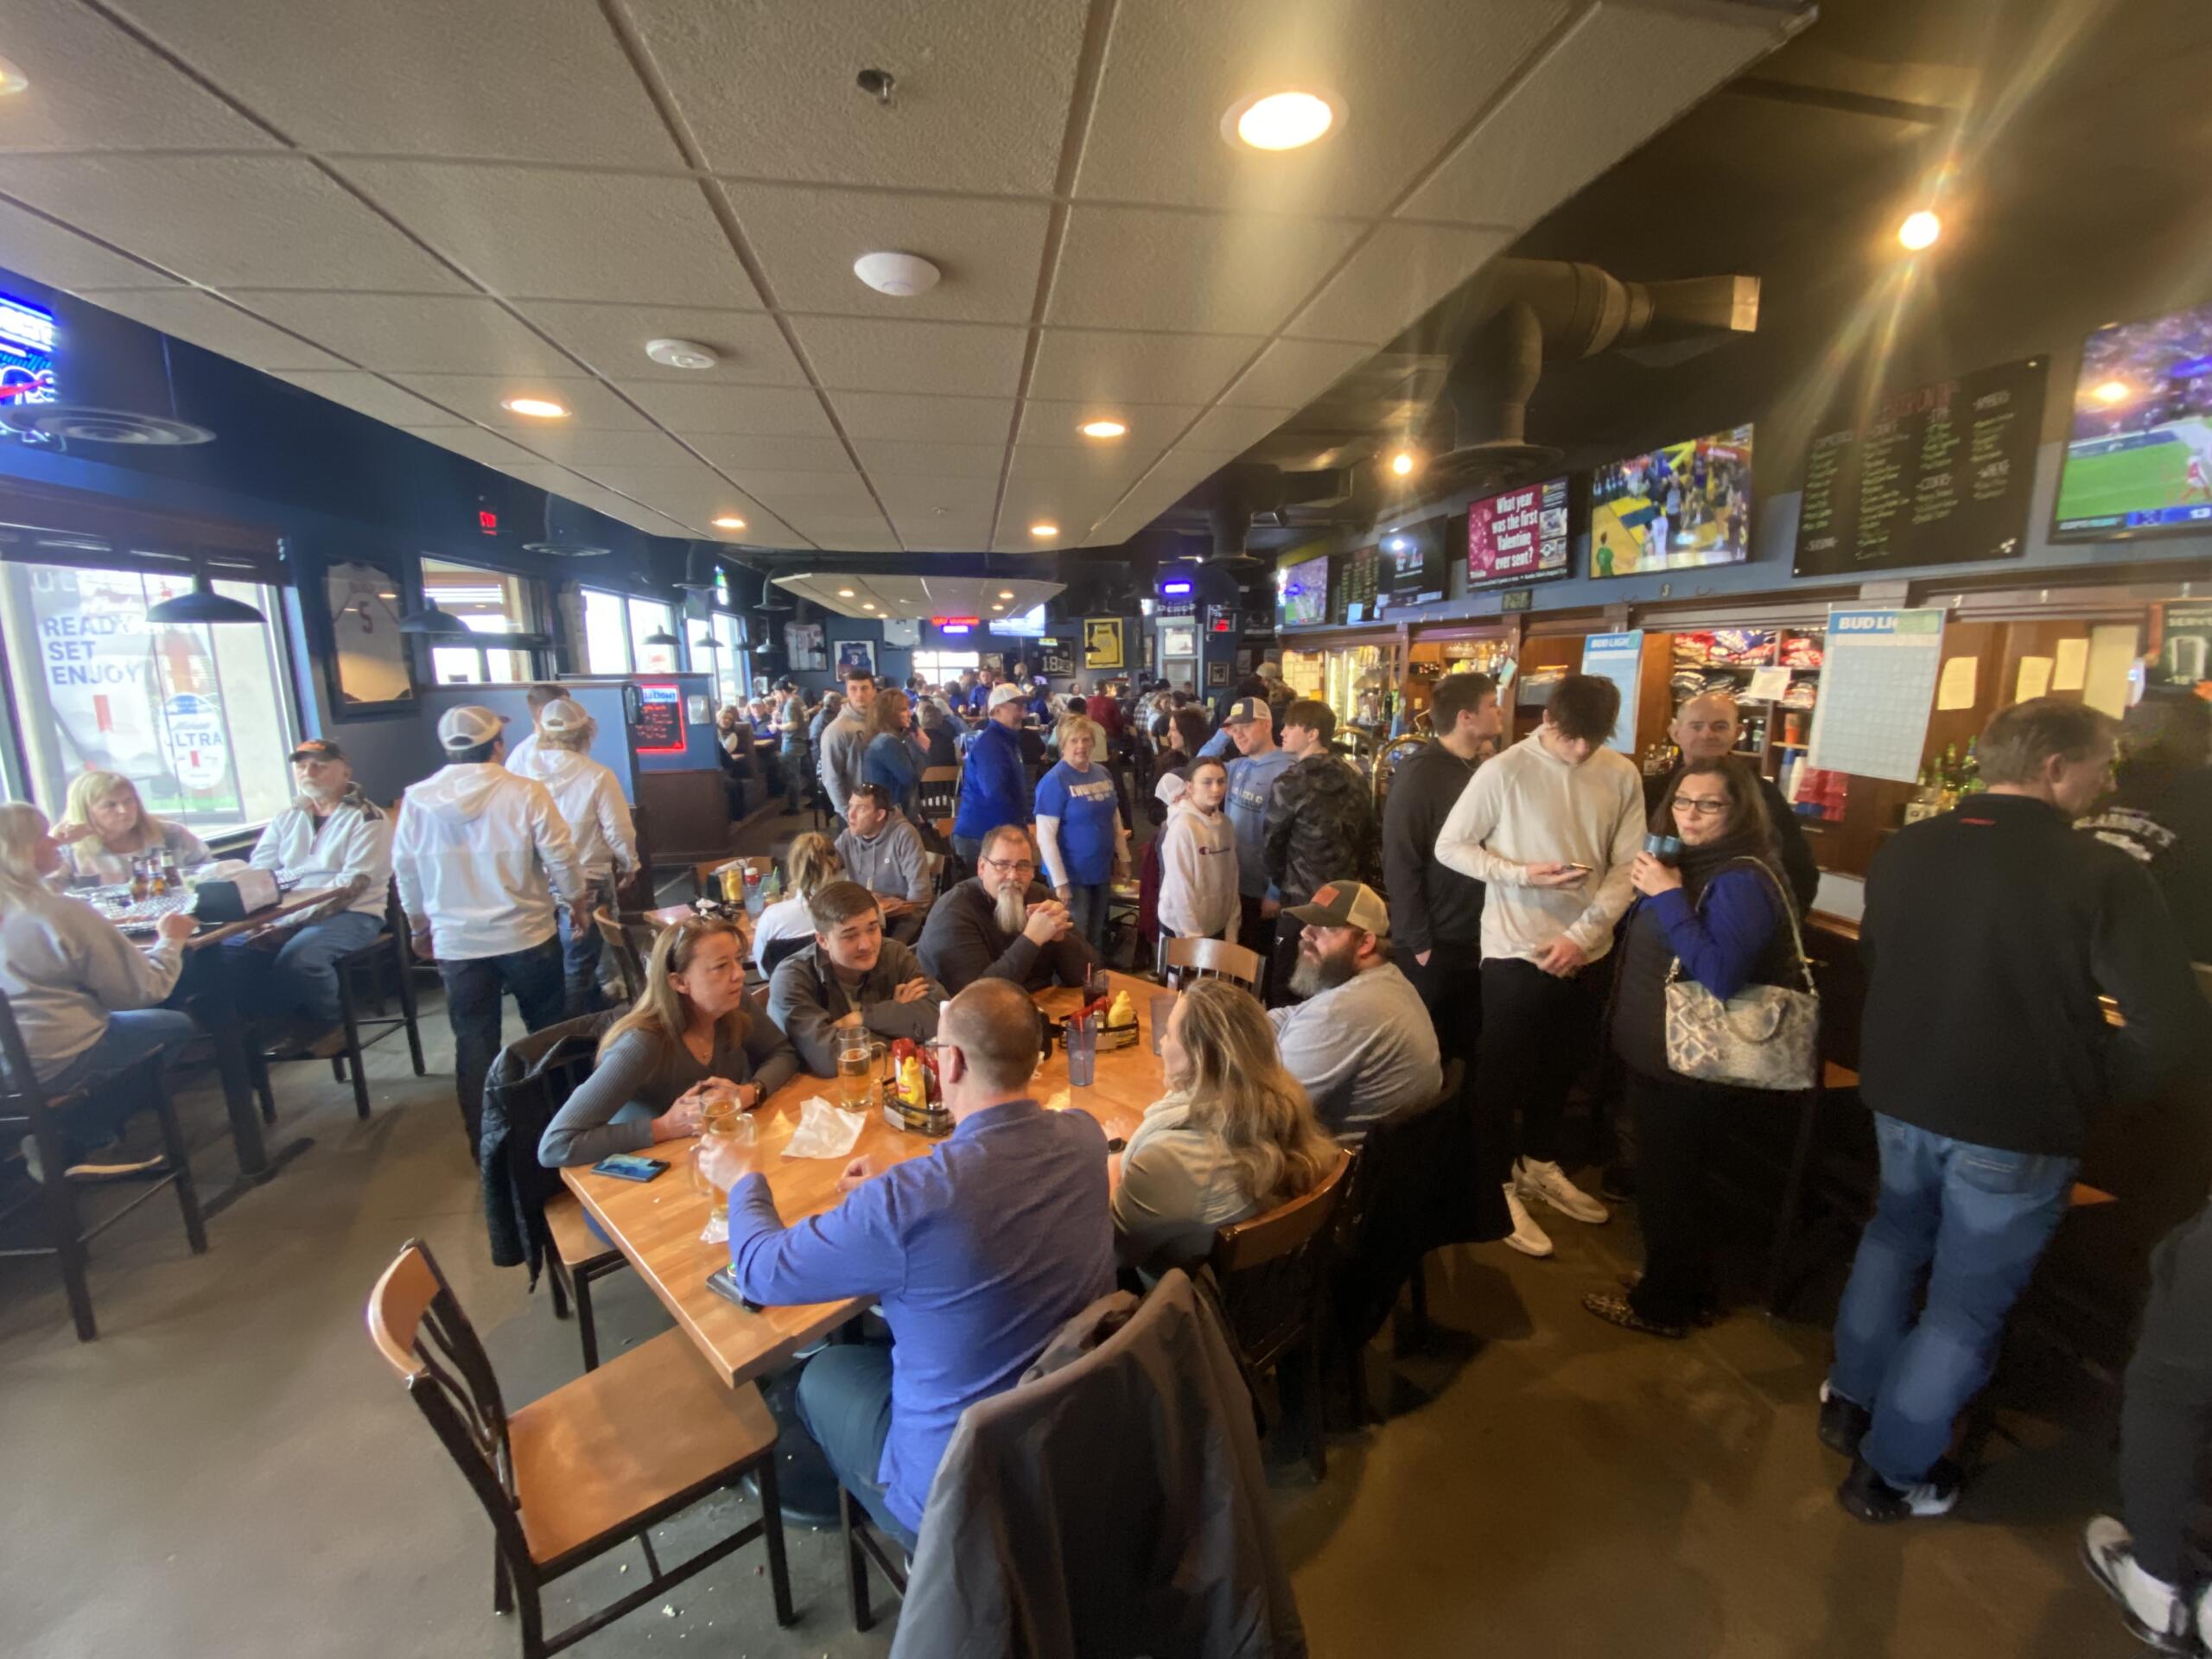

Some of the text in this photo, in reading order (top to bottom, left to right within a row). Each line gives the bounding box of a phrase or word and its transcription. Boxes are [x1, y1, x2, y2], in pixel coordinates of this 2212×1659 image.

[1491, 510, 1538, 534] was the first
[1838, 616, 1876, 629] BUD
[48, 640, 95, 661] SET
[52, 664, 139, 684] ENJOY
